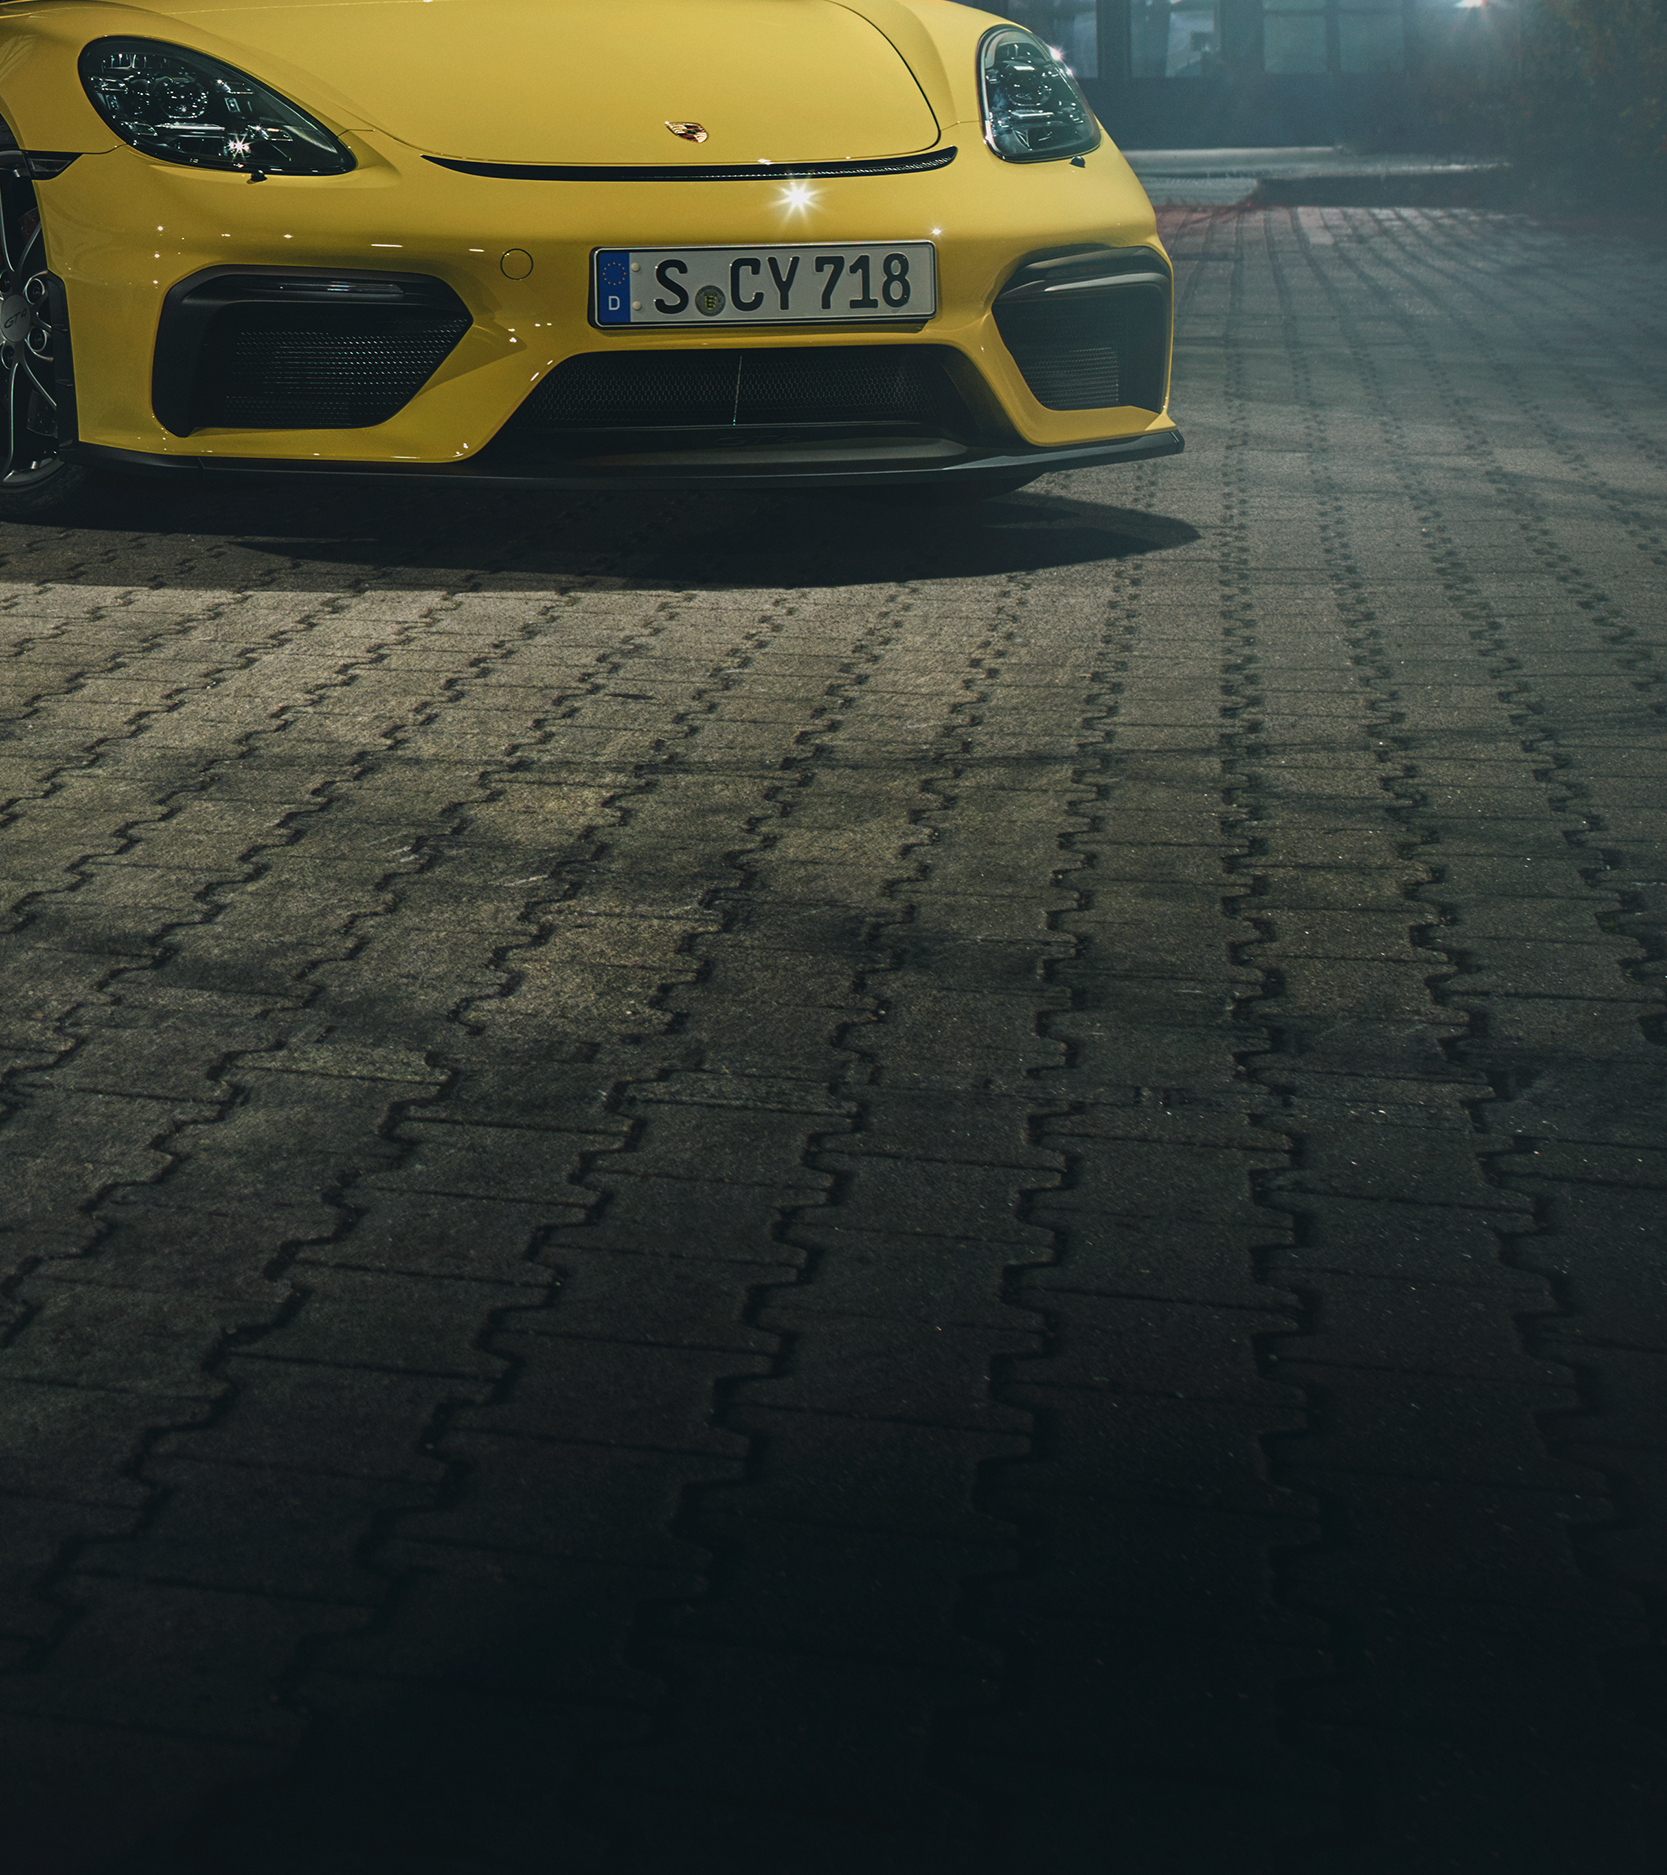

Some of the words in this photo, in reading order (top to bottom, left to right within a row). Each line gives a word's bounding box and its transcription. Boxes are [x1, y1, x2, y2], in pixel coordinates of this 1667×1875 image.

[653, 259, 690, 315] S
[608, 295, 621, 311] D
[4, 308, 27, 329] GT4
